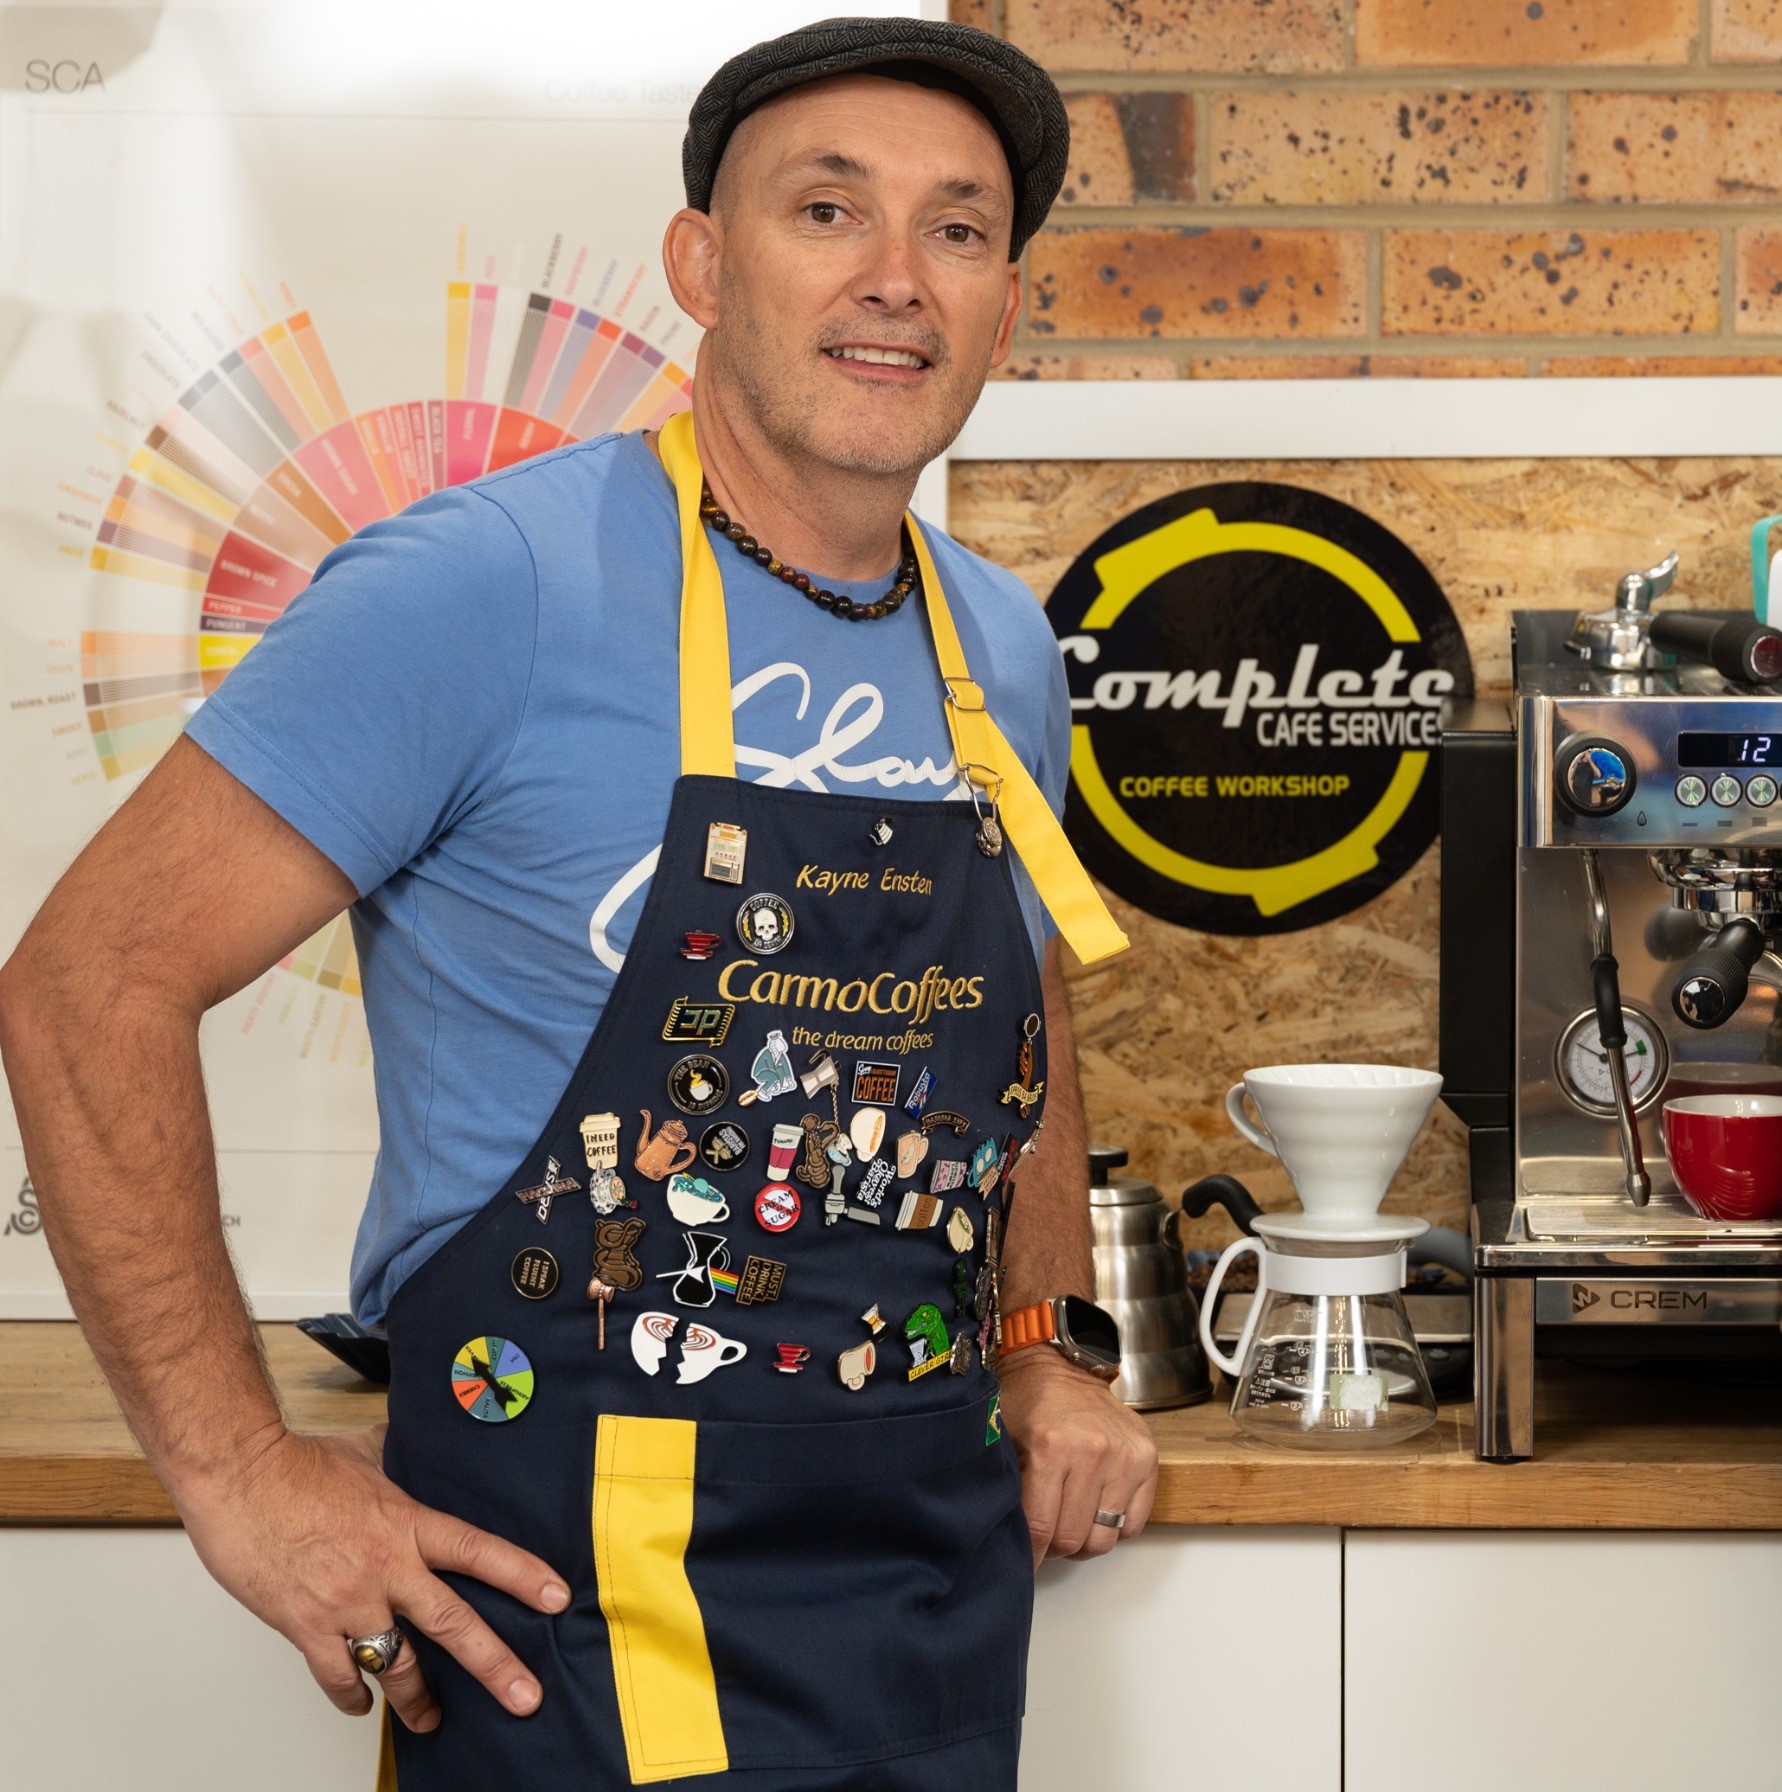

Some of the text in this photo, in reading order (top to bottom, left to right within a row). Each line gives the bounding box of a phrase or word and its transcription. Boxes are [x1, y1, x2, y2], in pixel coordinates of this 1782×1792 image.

[25, 58, 108, 94] SCA
[1057, 634, 1455, 728] Complete
[1257, 712, 1322, 746] CAFE
[1741, 736, 1771, 763] 12
[1119, 774, 1351, 797] COFFEE WORKSHOP
[796, 864, 933, 896] Kayne Ensten
[750, 898, 779, 911] COFFEE
[717, 959, 985, 1026] CarmoCoffees
[792, 1026, 934, 1055] the dream coffees
[686, 1059, 711, 1070] BEAN
[855, 1075, 896, 1102] COFFEE
[907, 1071, 930, 1110] Robusta
[586, 1144, 617, 1157] COFFEE
[590, 1132, 615, 1143] NEED
[856, 1158, 881, 1202] Barista
[864, 1159, 889, 1206] Okayest
[870, 1164, 897, 1208] World's
[758, 1188, 794, 1214] CREAM
[916, 1196, 932, 1227] coffee
[764, 1203, 800, 1228] SUGAR
[520, 1257, 532, 1285] COFFEE
[529, 1259, 541, 1288] FLUENT
[537, 1265, 550, 1291] SPEAK
[1610, 1290, 1707, 1309] CREM
[909, 1361, 934, 1379] CLEVER
